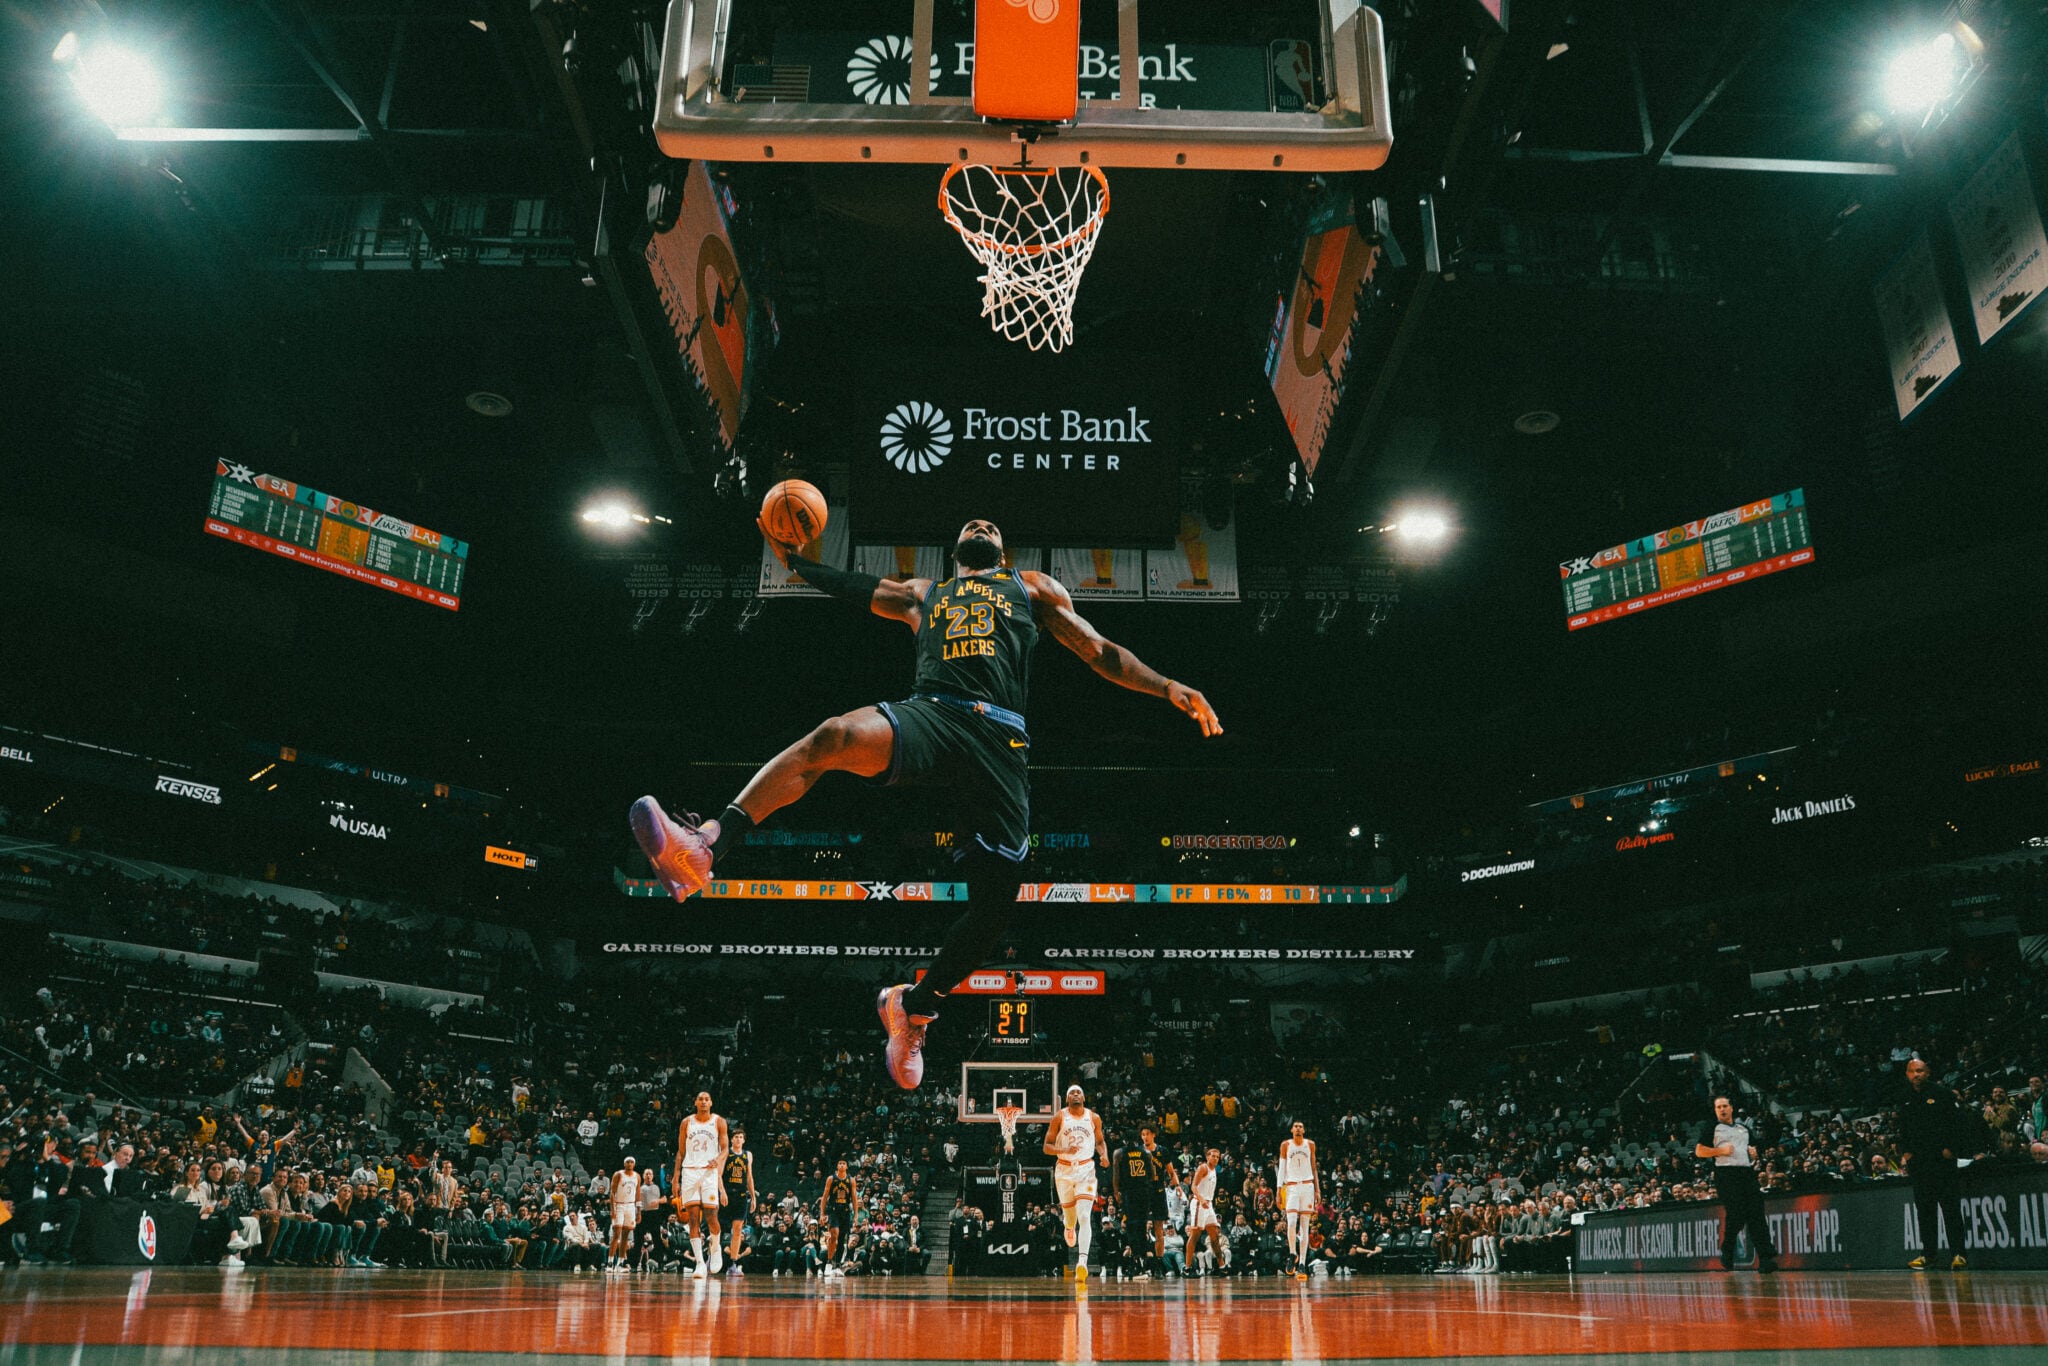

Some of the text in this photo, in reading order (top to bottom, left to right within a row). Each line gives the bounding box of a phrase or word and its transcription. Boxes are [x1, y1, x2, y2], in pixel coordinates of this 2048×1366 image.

[963, 406, 1152, 443] Frost Bank
[987, 453, 1120, 470] CENTER
[270, 479, 316, 506] SA 4
[1743, 502, 1771, 518] LAL
[1784, 492, 1793, 508] 2
[414, 529, 439, 545] LAL
[450, 540, 460, 555] 2
[1604, 539, 1645, 560] SA 4
[629, 589, 669, 599] 1999
[678, 589, 723, 599] 2003
[929, 580, 1012, 629] LOS ANGELES
[946, 602, 995, 640] 23
[943, 639, 995, 661] LAKERS
[0, 745, 34, 763] BELL
[1964, 758, 2041, 783] LUCKY EAGLE
[349, 818, 388, 840] USAA
[934, 831, 954, 847] TAC
[1043, 833, 1091, 849] CERVEZA
[1615, 835, 1649, 852] Bally
[492, 851, 522, 863] HOLT
[1469, 859, 1535, 881] DOCUMATION
[711, 883, 728, 895] TO
[738, 883, 744, 896] 7
[751, 883, 783, 896] FG%
[819, 884, 836, 896] PF
[845, 884, 852, 897] 0
[906, 885, 929, 900] SA
[947, 884, 955, 900] 4
[1046, 887, 1084, 902] LAKERS
[1095, 886, 1130, 900] LAL
[1150, 885, 1157, 901] 2
[1176, 888, 1193, 899] PF
[1203, 888, 1210, 900] 0
[1218, 888, 1249, 900] FG%
[1259, 888, 1272, 901] 33
[1284, 888, 1301, 900] TO
[1309, 888, 1315, 900] 7
[603, 943, 943, 957] GARRISON BROTHERS DISTILL
[1044, 948, 1415, 959] GARRISON BROTHERS DISTILLERY
[998, 1015, 1024, 1035] 21
[693, 1139, 708, 1152] 24
[1068, 1136, 1084, 1146] 22
[1129, 1160, 1146, 1177] 12
[976, 1176, 997, 1185] WATCH
[1002, 1191, 1015, 1202] GET
[1002, 1202, 1015, 1213] THE
[1002, 1213, 1015, 1223] APP
[1904, 1202, 1924, 1250] AL
[1937, 1195, 2015, 1250] ACESS.
[1579, 1230, 1593, 1261] ALL
[1593, 1227, 1624, 1260] ACCESS.
[1625, 1226, 1640, 1260] ALL
[1640, 1223, 1676, 1258] SEASON.
[1677, 1221, 1694, 1257] ALL
[1766, 1213, 1784, 1254] ET
[1785, 1211, 1811, 1252] THE
[1814, 1209, 1842, 1253] APP.
[987, 1243, 1029, 1255] KIA
